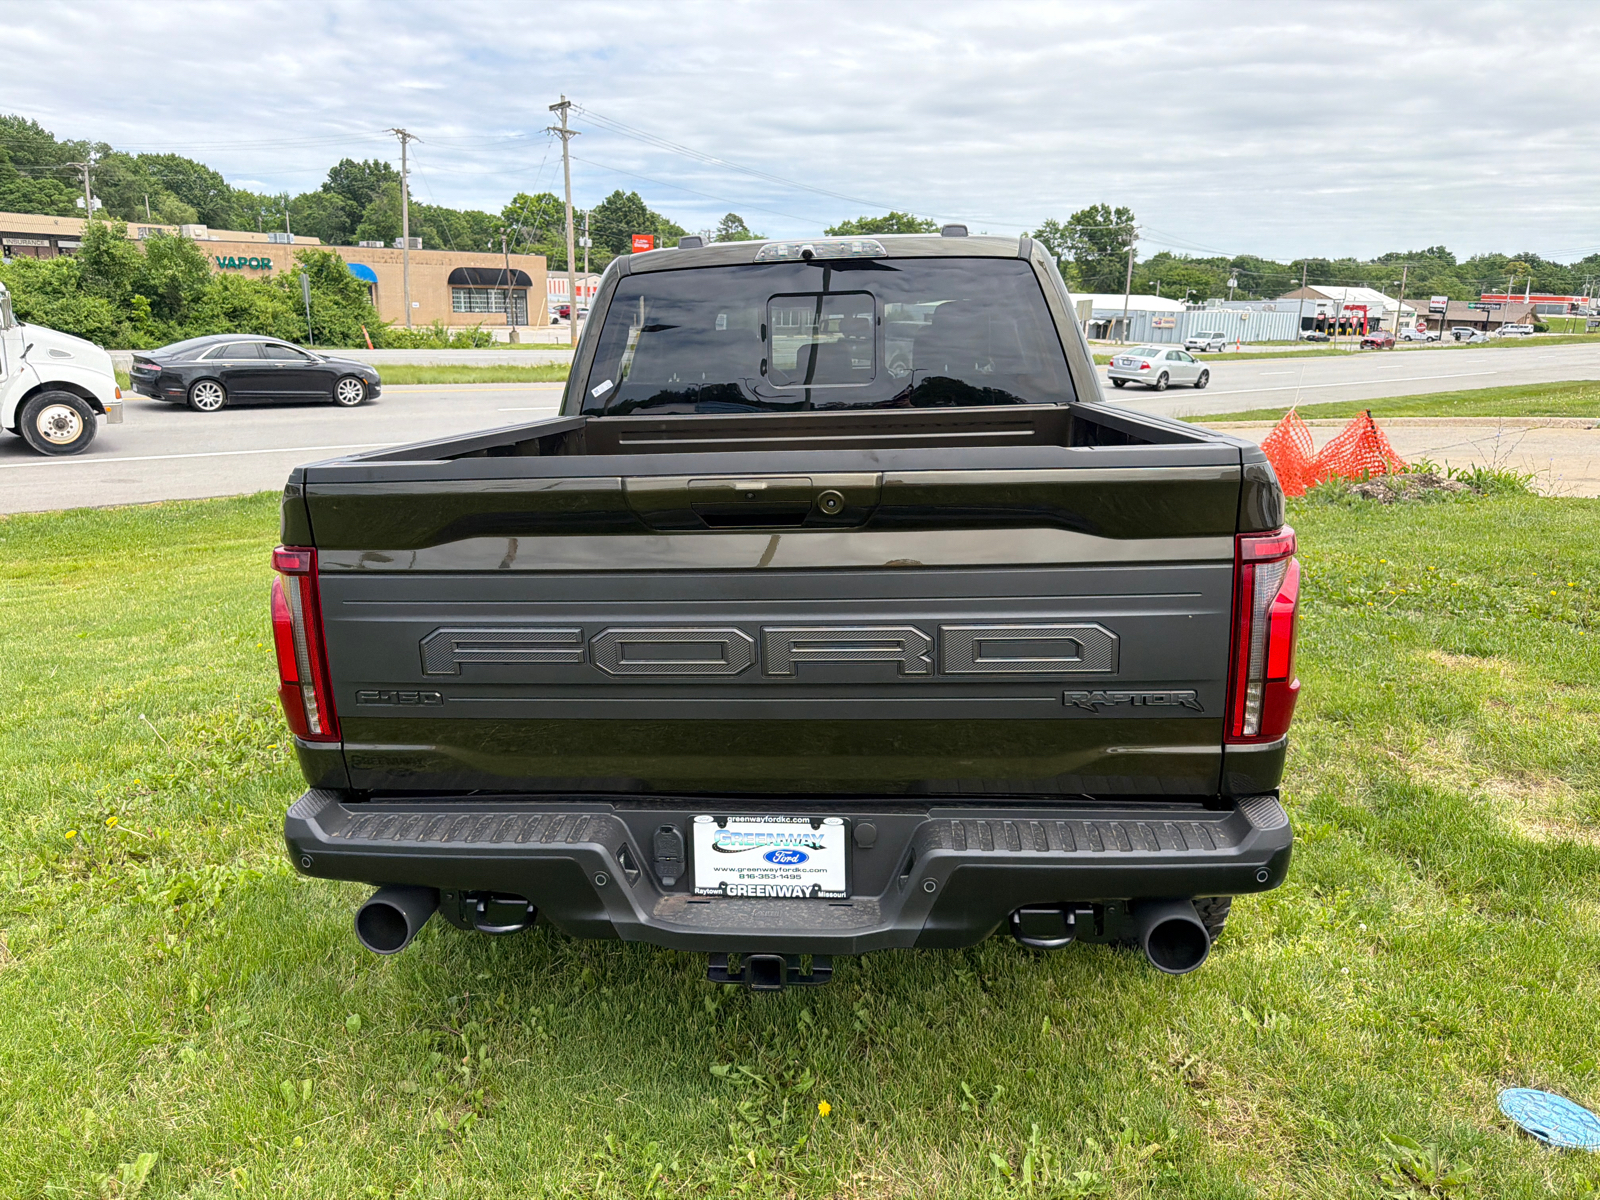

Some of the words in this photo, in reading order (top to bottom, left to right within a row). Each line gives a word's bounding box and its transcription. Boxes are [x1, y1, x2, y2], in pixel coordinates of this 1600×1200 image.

[215, 256, 272, 270] VAPOR
[420, 622, 1119, 677] FORD
[1063, 690, 1204, 714] RAPTOR
[727, 815, 810, 824] greenwayfordkc.com
[714, 829, 824, 847] GREENWAY
[772, 850, 800, 863] Ford
[694, 887, 723, 895] Raytown
[726, 884, 813, 898] GREENWAY
